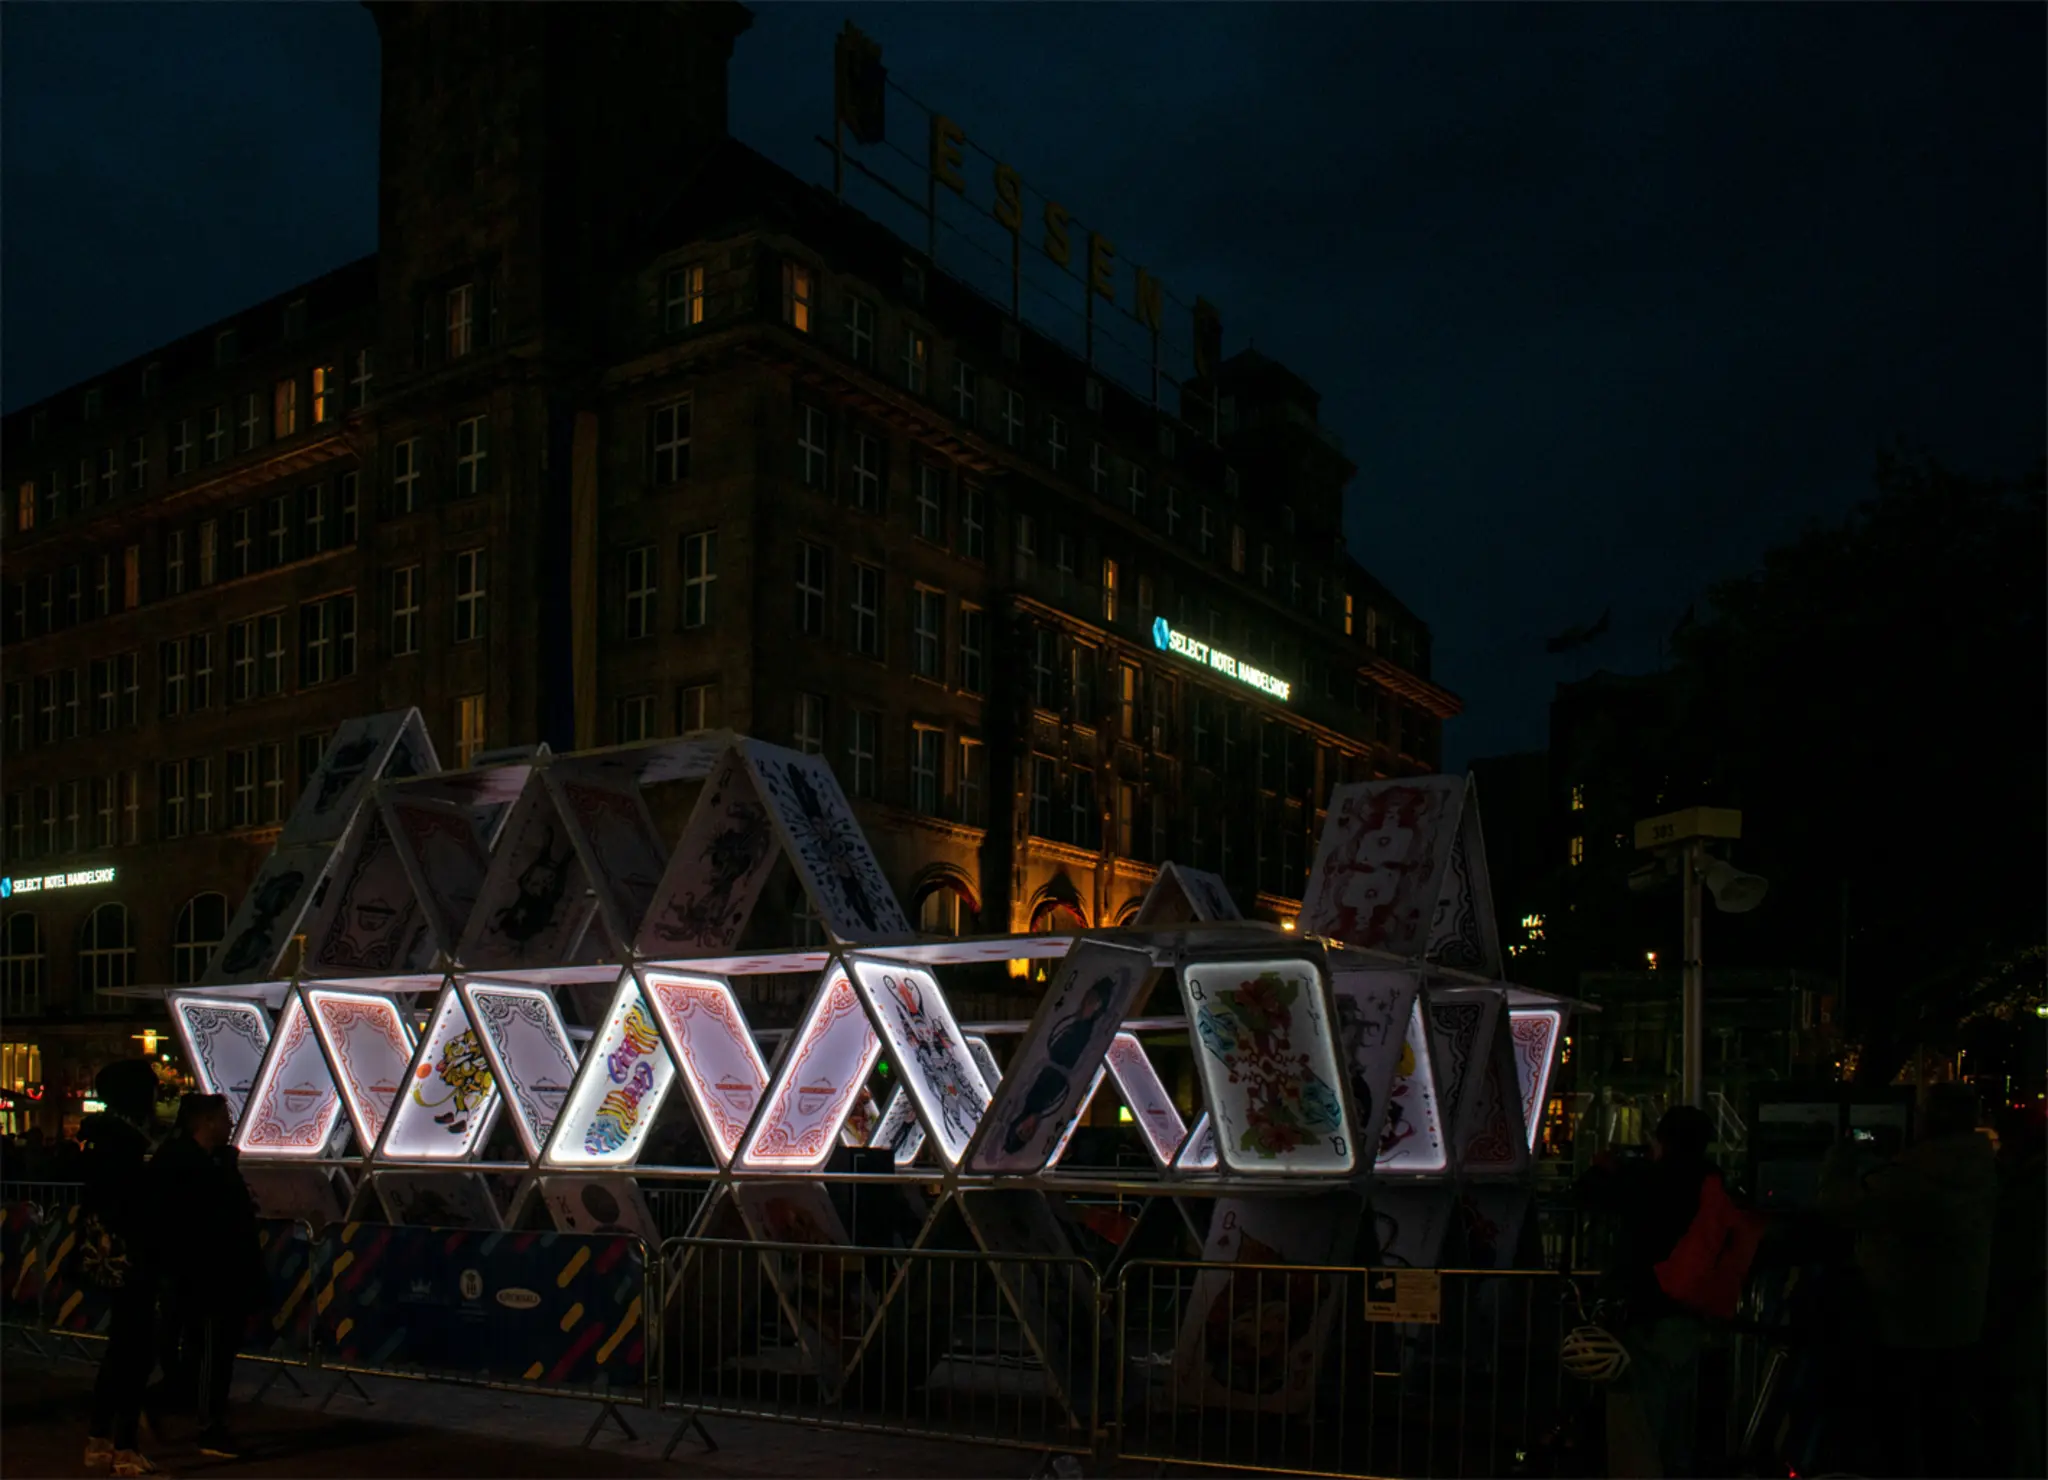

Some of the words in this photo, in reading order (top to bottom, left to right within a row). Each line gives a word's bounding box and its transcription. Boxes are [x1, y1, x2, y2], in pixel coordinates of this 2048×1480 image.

[932, 113, 1163, 332] ESSEN
[1168, 629, 1209, 664] SELECT
[1210, 649, 1238, 678] HOTEL
[1238, 661, 1291, 701] HANDELSHOF
[12, 876, 43, 894] SELECT
[43, 873, 67, 890] HOTEL
[66, 867, 116, 887] HANDELSHOF
[1189, 979, 1208, 1001] Q
[1328, 1135, 1347, 1157] Q
[1222, 1210, 1236, 1230] Q
